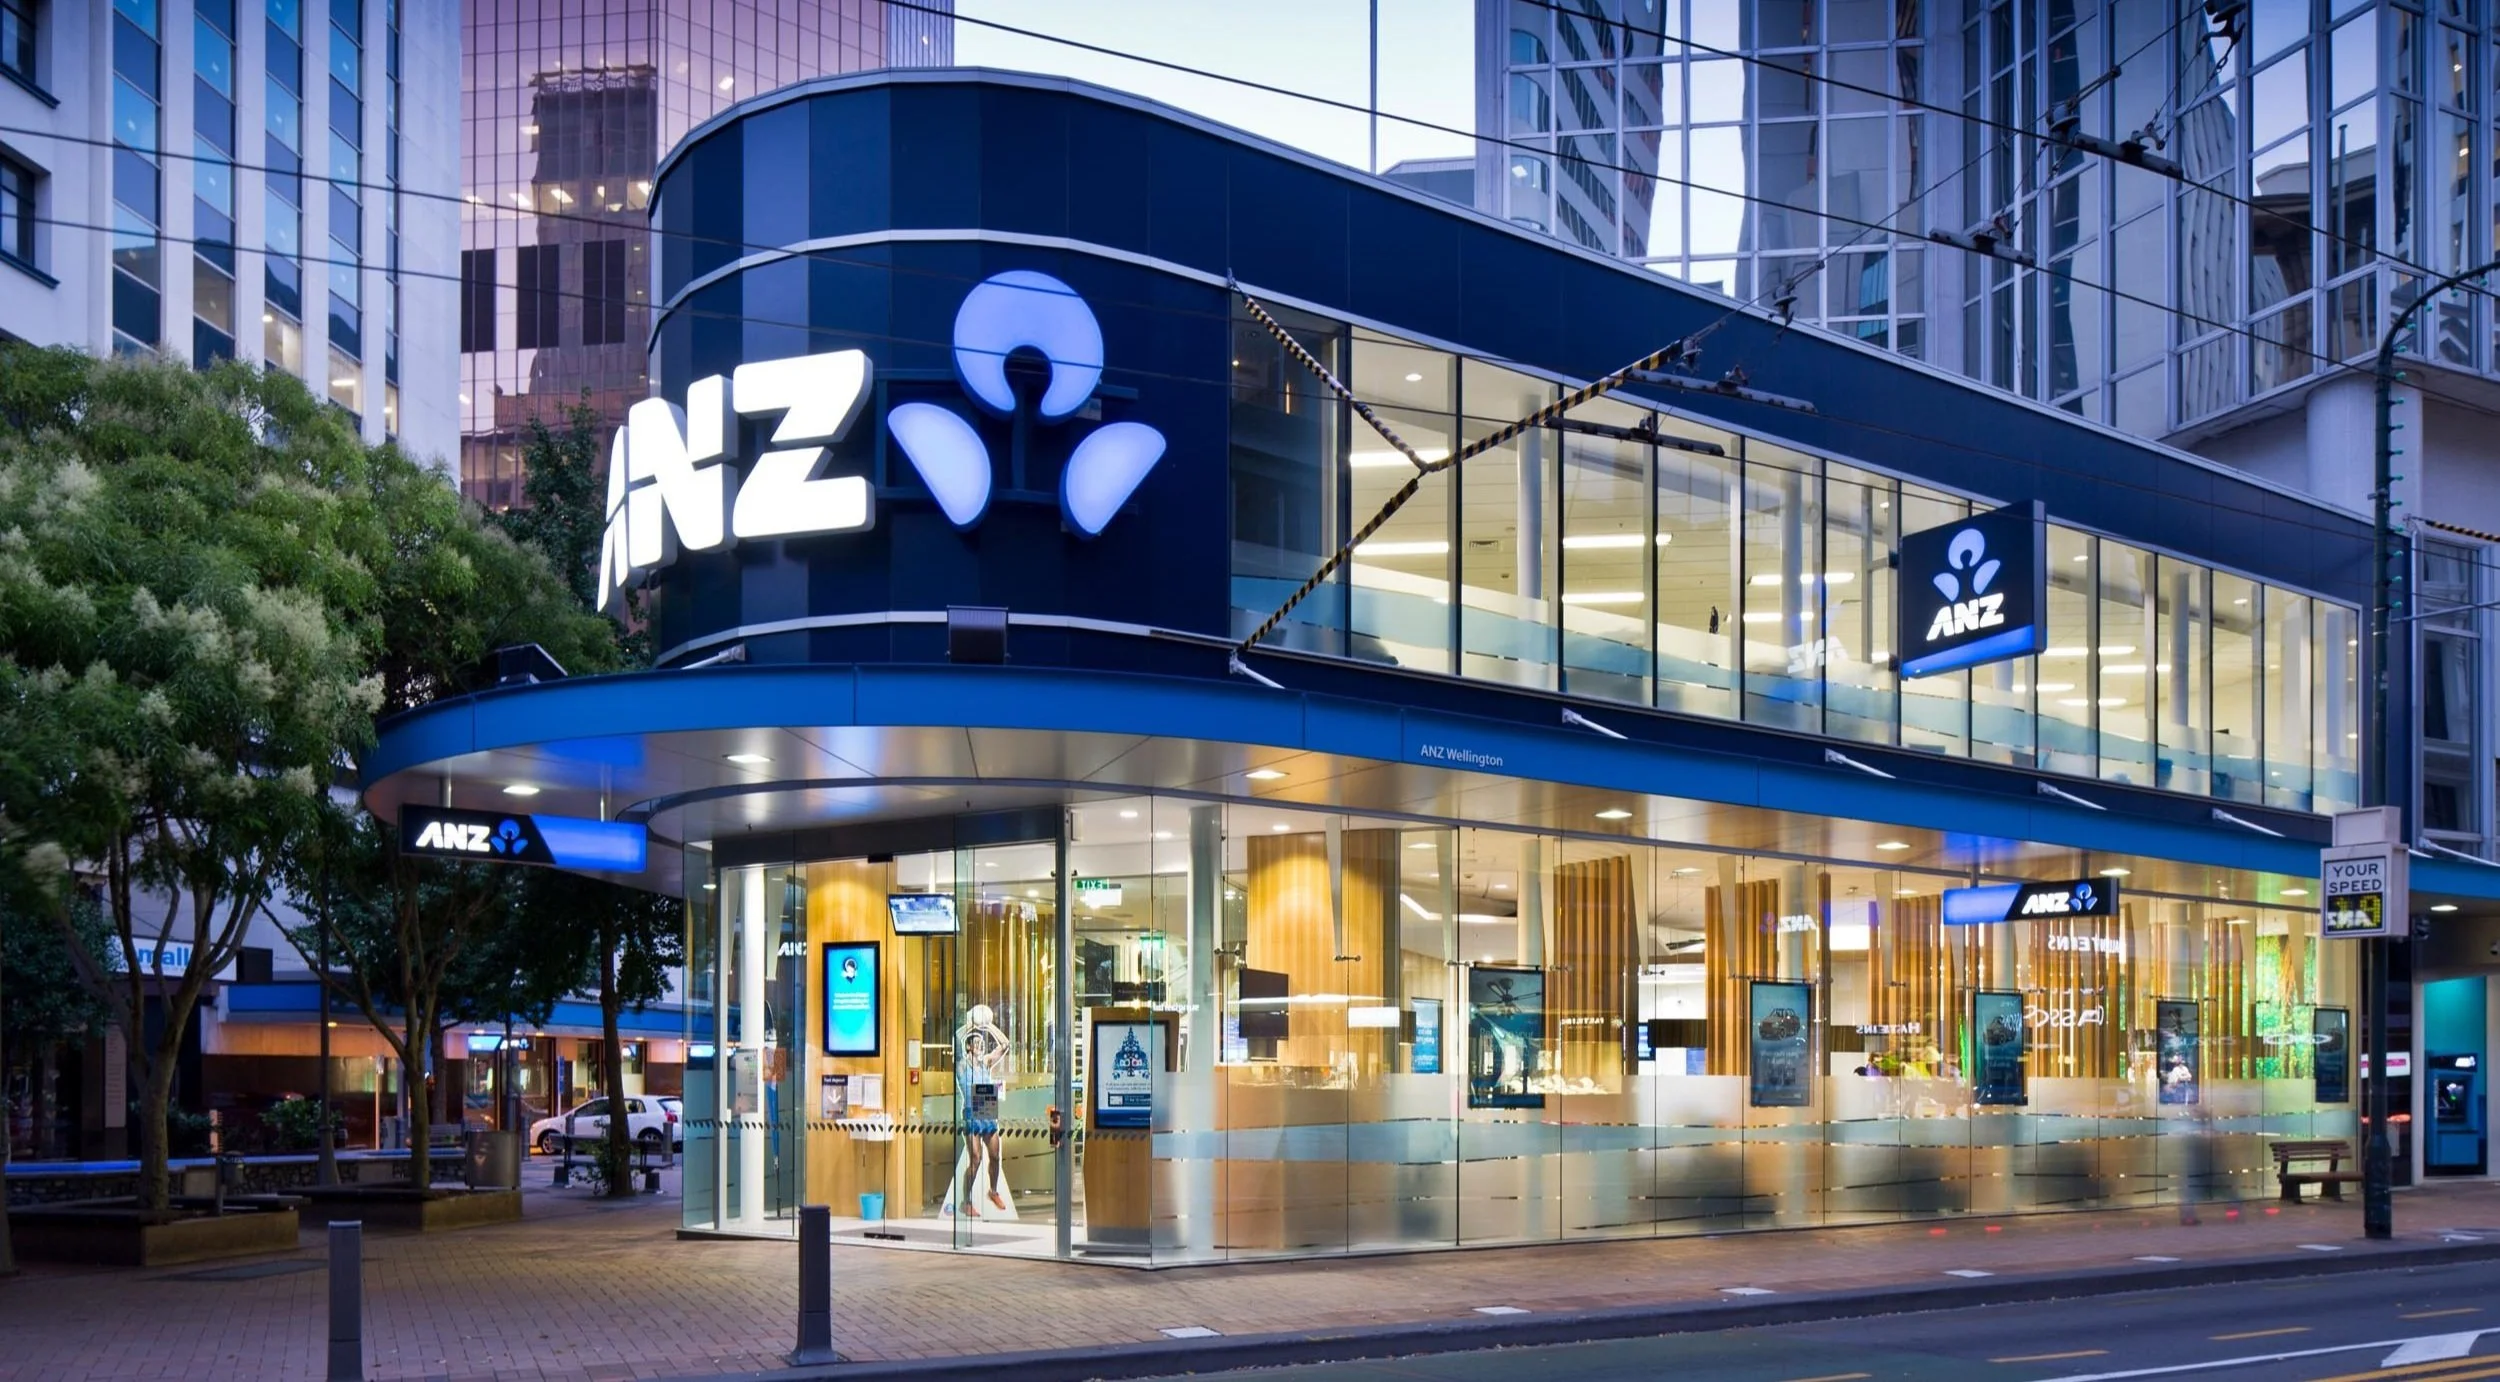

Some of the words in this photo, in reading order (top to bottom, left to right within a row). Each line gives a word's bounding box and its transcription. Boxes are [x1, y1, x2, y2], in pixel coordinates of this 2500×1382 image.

[597, 349, 873, 612] ANZ
[1926, 593, 2004, 642] ANZ
[1421, 744, 1444, 759] ANZ
[1446, 748, 1503, 767] Wellington
[416, 821, 490, 852] ANZ
[2333, 863, 2378, 877] YOUR
[2329, 879, 2382, 893] SPEED
[2022, 892, 2070, 914] ANZ
